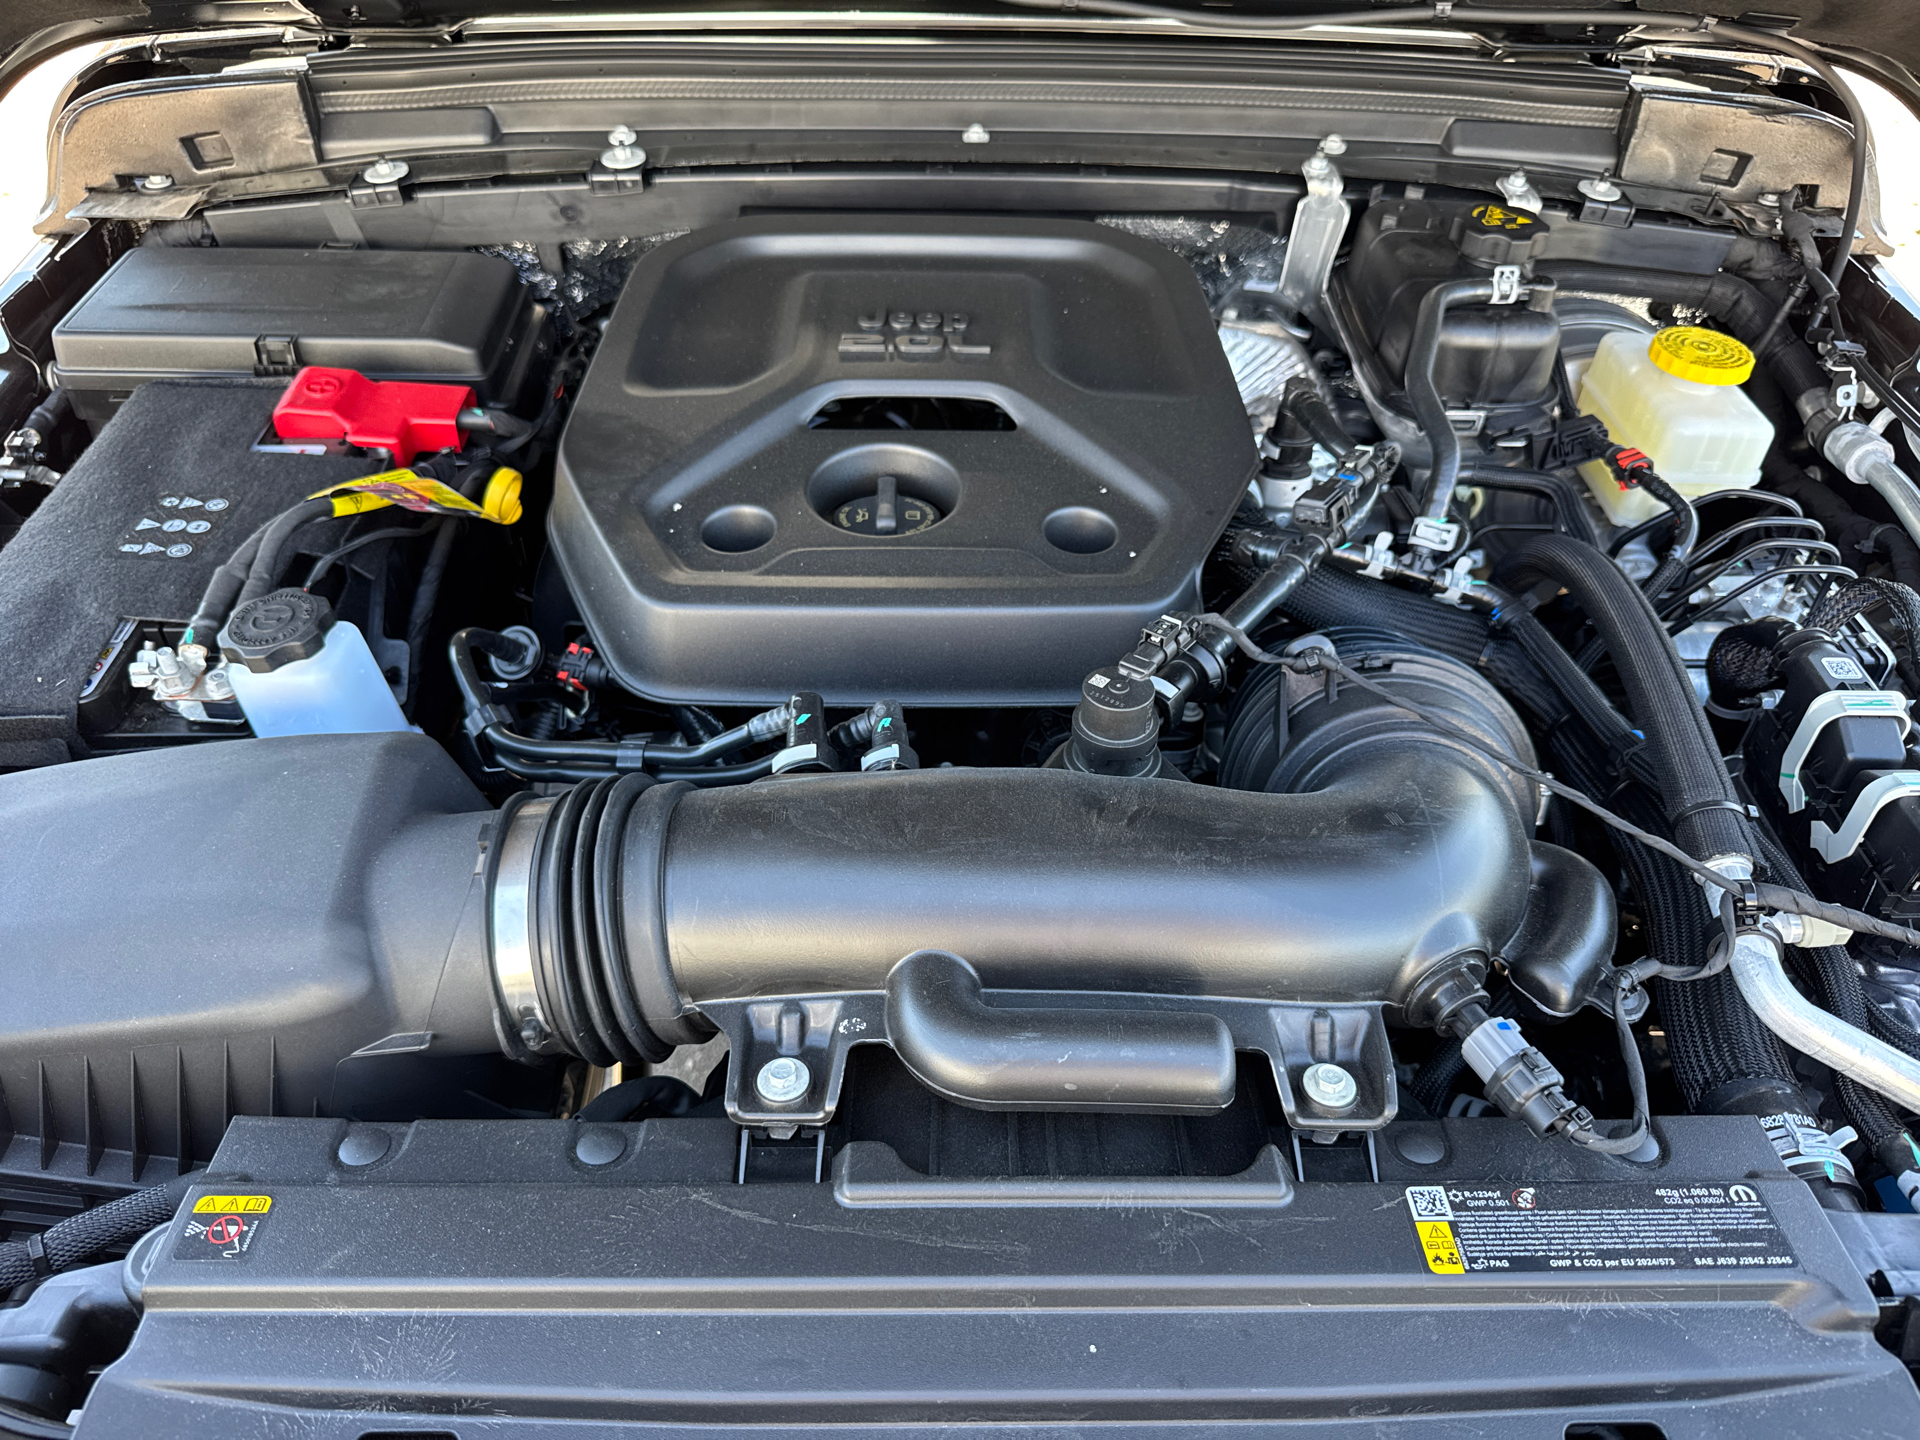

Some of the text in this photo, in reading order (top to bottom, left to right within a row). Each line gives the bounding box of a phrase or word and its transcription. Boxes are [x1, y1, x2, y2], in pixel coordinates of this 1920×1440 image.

[857, 308, 969, 331] Jeep
[838, 333, 991, 357] 2.0L
[1760, 1113, 1817, 1129] 6828781AD
[1463, 1190, 1501, 1199] R-1234yf
[1655, 1187, 1724, 1198] 482g (1.060 lb)
[1466, 1199, 1510, 1208] GWP 0.501
[1664, 1197, 1683, 1205] CO2
[1693, 1197, 1725, 1205] 0.00024
[1490, 1259, 1510, 1268] PAG
[1550, 1259, 1572, 1268] GWP
[1583, 1258, 1602, 1267] CO2
[1604, 1259, 1620, 1268] per
[1621, 1258, 1635, 1266] EU
[1636, 1257, 1676, 1266] 2024/573
[1694, 1256, 1793, 1266] SAE J639 J2842 J2845
